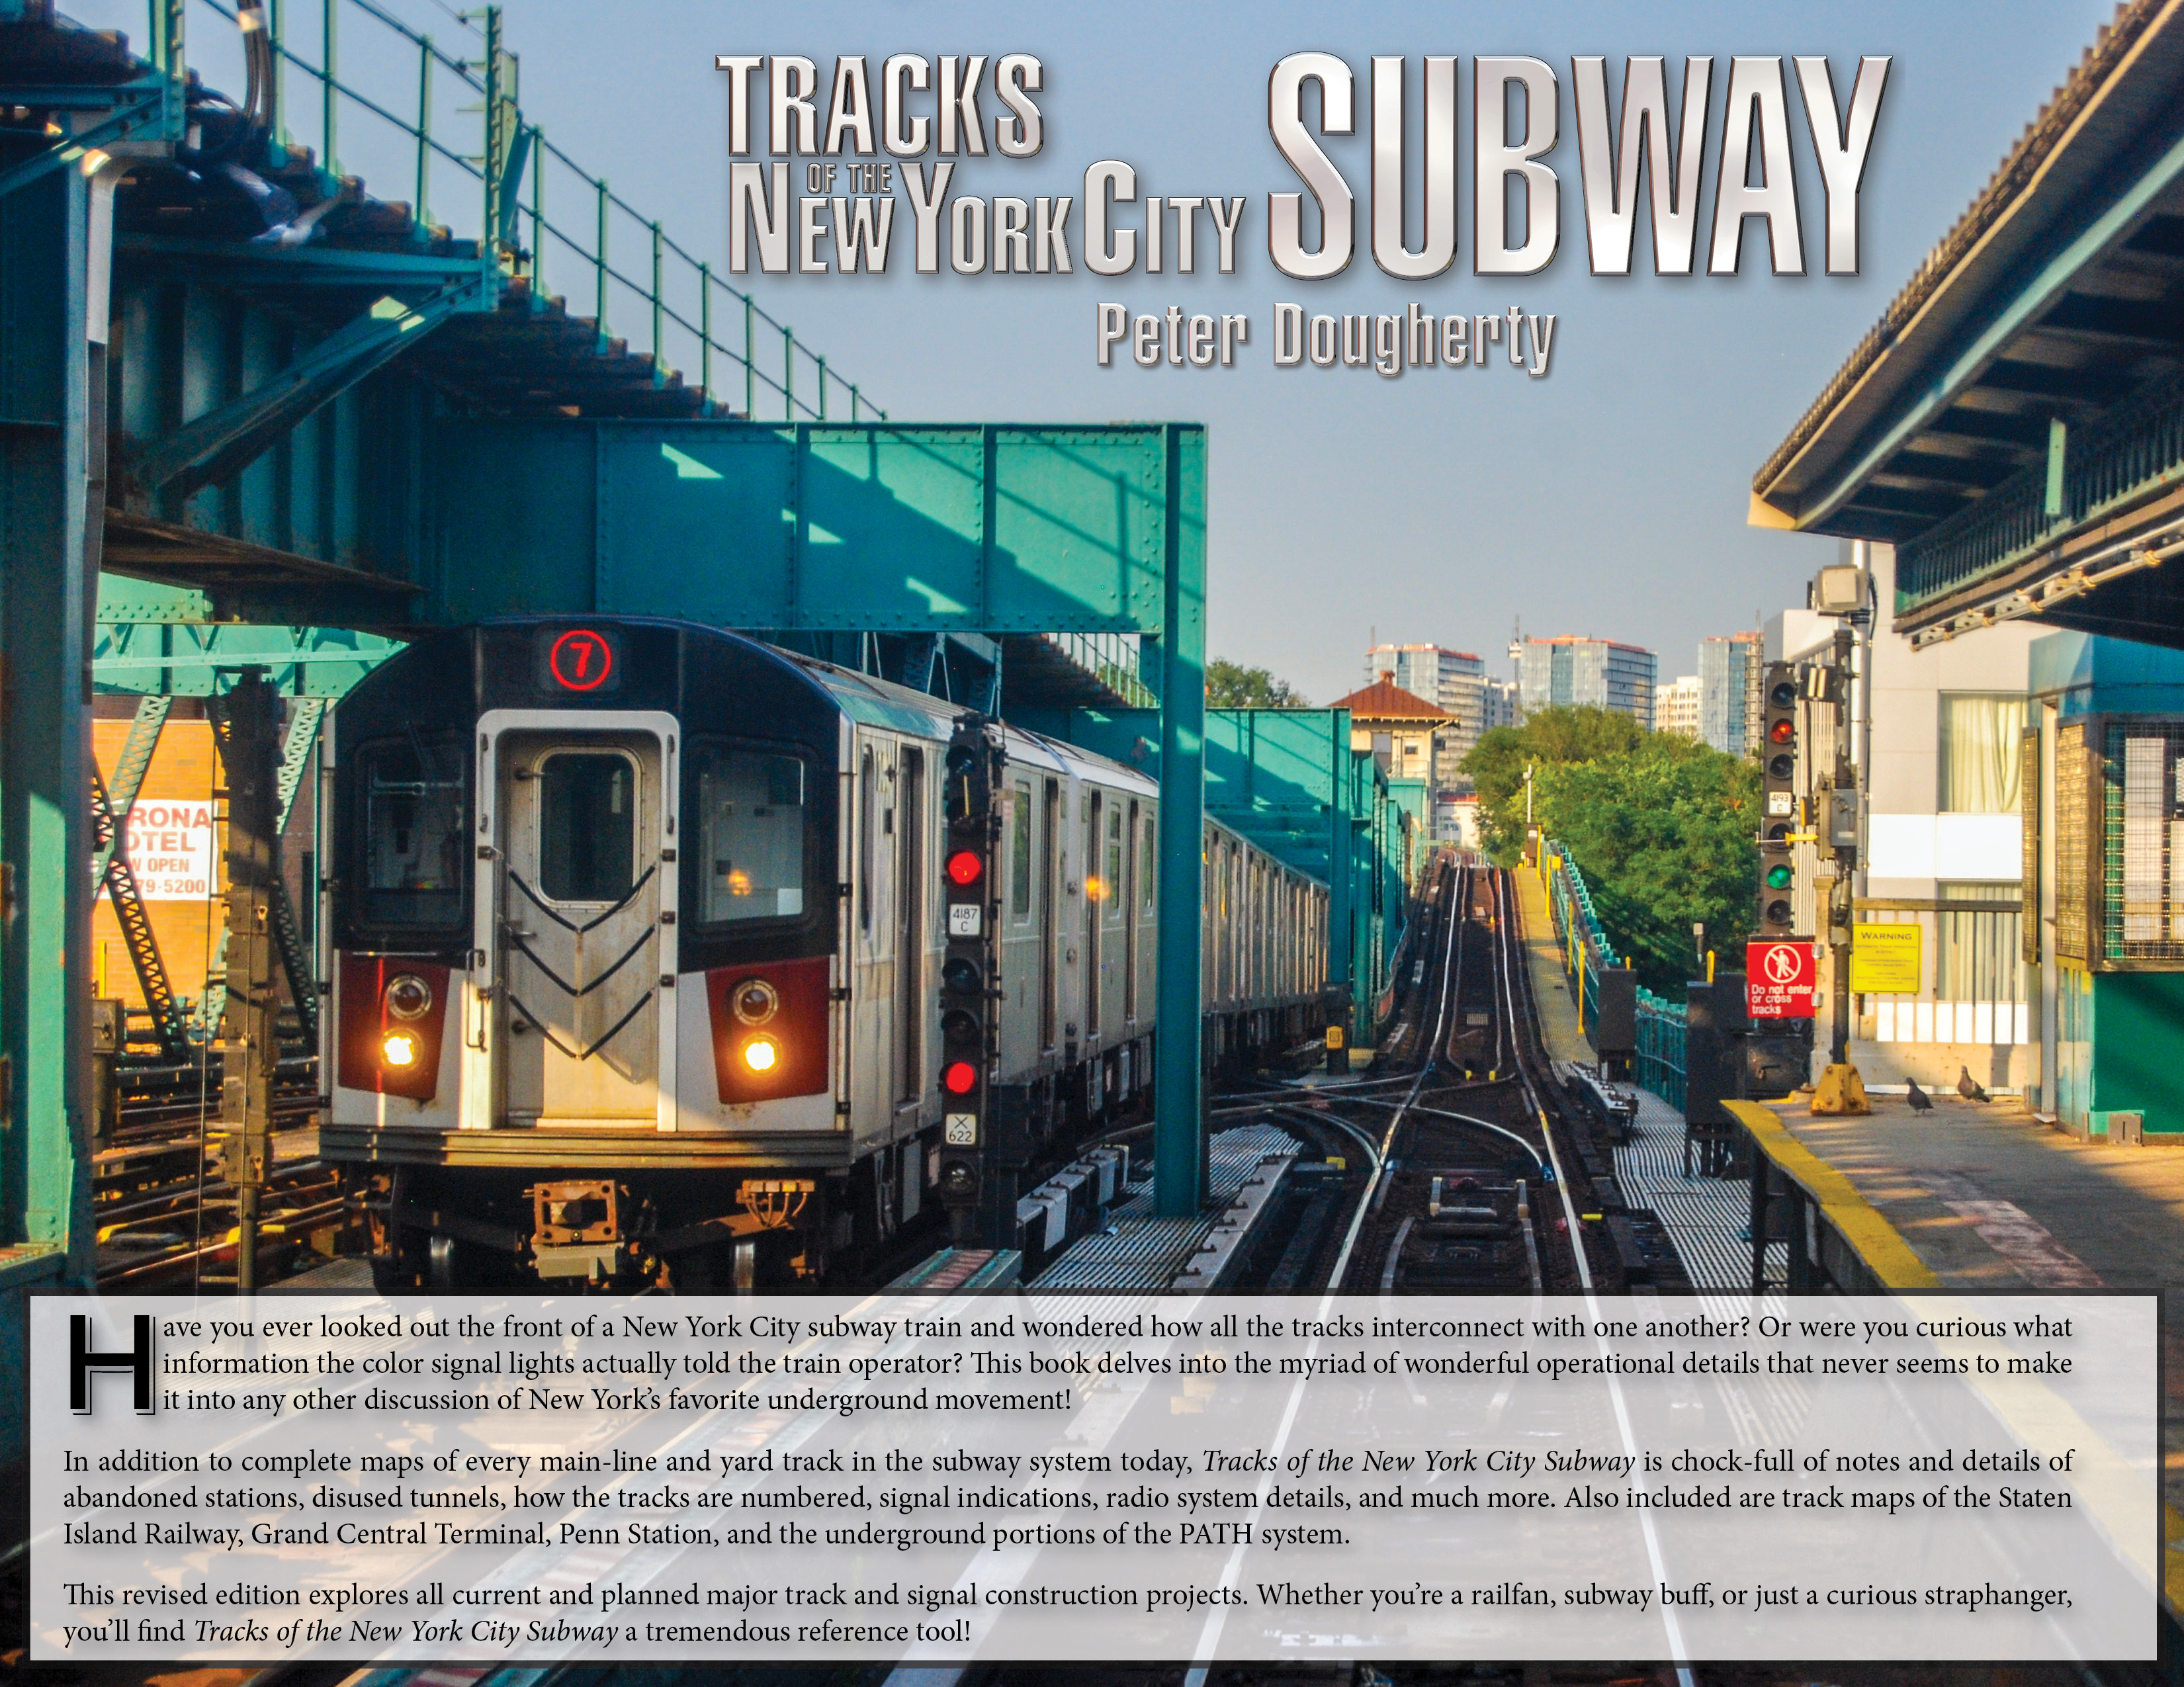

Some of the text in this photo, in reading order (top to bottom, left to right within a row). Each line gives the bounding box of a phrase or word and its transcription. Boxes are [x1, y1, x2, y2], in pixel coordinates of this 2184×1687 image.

[570, 642, 593, 678] 7
[128, 806, 212, 828] RONA
[128, 830, 197, 852] OTEL
[147, 857, 190, 873] OPEN
[952, 907, 978, 920] 4187
[961, 921, 969, 932] C
[1860, 931, 1912, 940] WARNING
[1751, 984, 1813, 994] Do not enter
[1751, 994, 1792, 1004] or cross
[1752, 1004, 1782, 1014] tracks
[953, 1115, 969, 1129] X
[948, 1131, 973, 1143] 622
